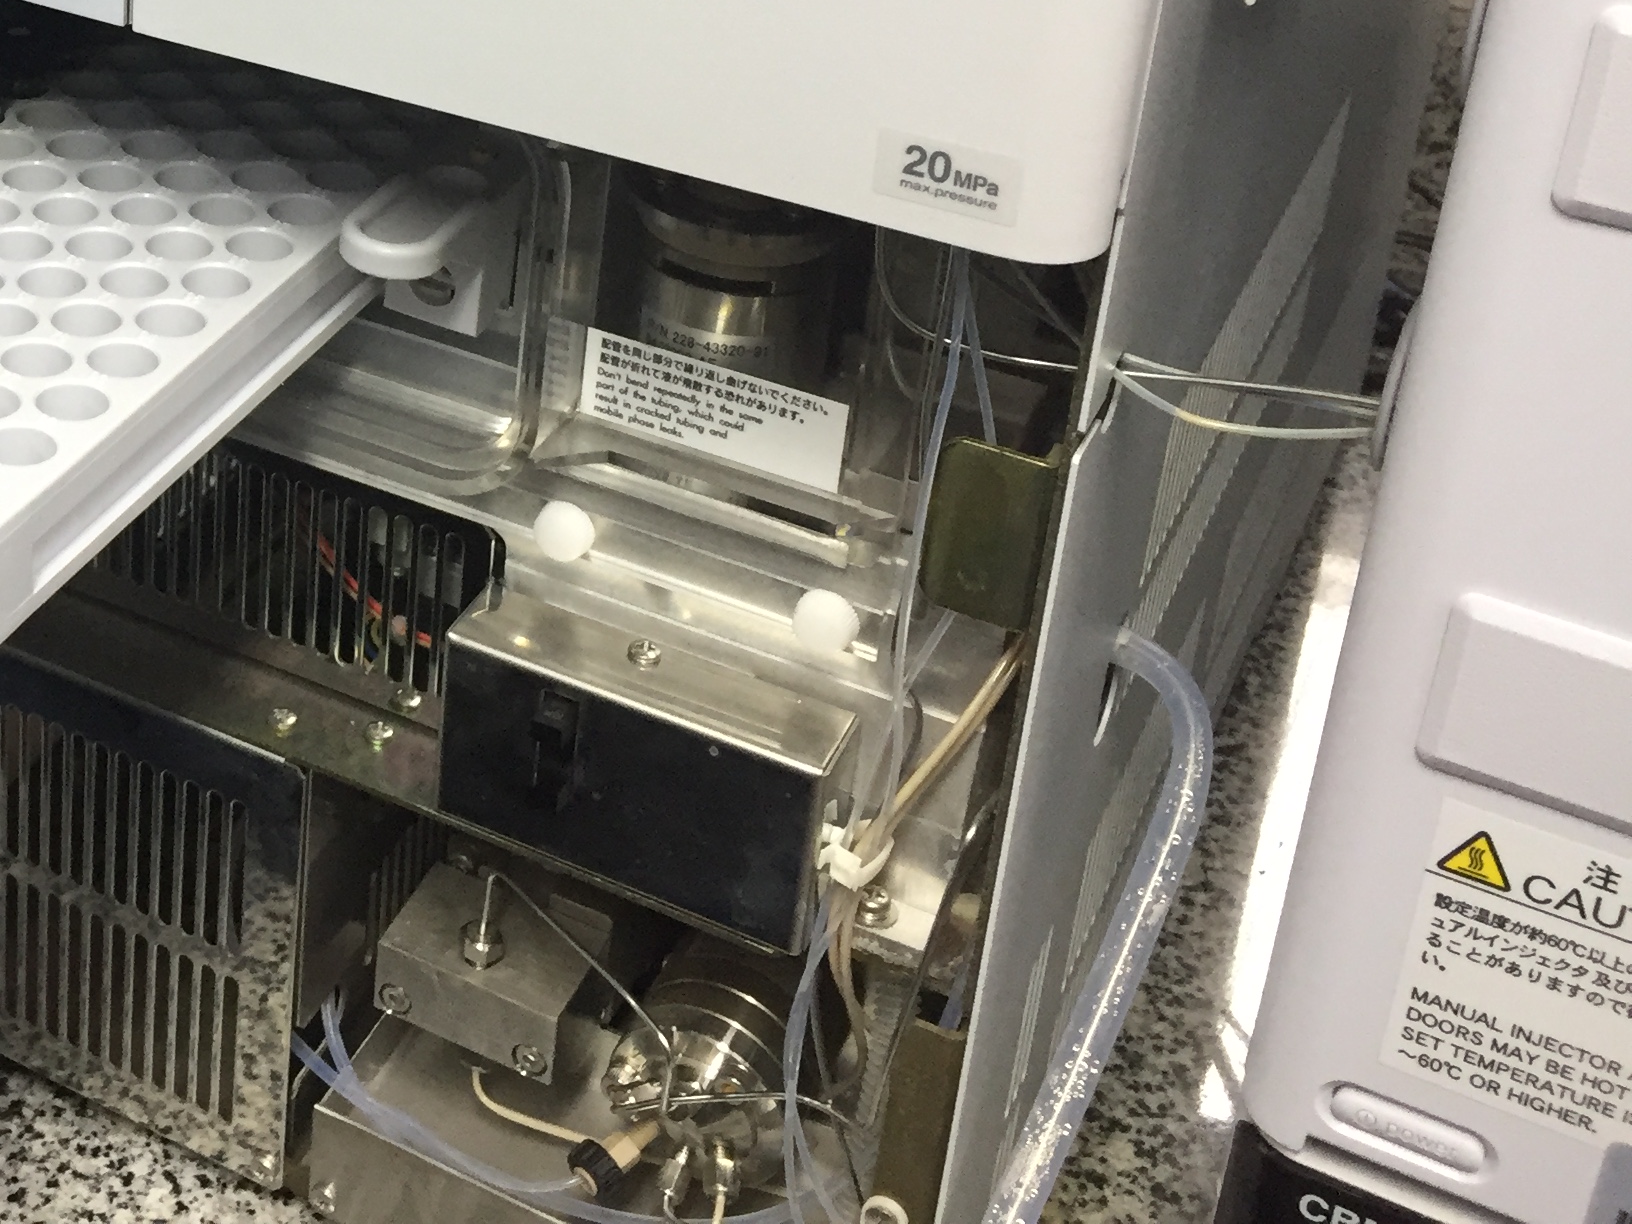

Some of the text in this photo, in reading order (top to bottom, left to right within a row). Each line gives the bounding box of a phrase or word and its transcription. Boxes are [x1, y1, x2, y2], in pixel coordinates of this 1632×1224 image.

[902, 144, 1000, 197] 20 MPa
[593, 404, 624, 420] mobile
[628, 415, 655, 430] phase
[595, 392, 728, 440] result in cracked tubing and
[596, 380, 615, 392] part
[618, 386, 628, 396] of
[633, 390, 647, 402] the
[687, 408, 714, 423] which
[719, 419, 745, 432] could
[625, 374, 649, 390] bend
[653, 385, 701, 407] repeatedly
[706, 398, 715, 410] in
[719, 403, 734, 416] the
[739, 412, 764, 425] same
[1523, 875, 1632, 929] CAU
[1582, 860, 1622, 895] 注
[1406, 1006, 1630, 1101] DOORS MAY BE HOT
[1410, 986, 1623, 1078] MANUAL INJECTOR
[1401, 1026, 1445, 1051] SET
[1451, 1042, 1617, 1119] TEMPERATURE
[1469, 1073, 1501, 1096] OR
[1507, 1087, 1597, 1134] HIGHER.
[1298, 1193, 1378, 1224] CB
